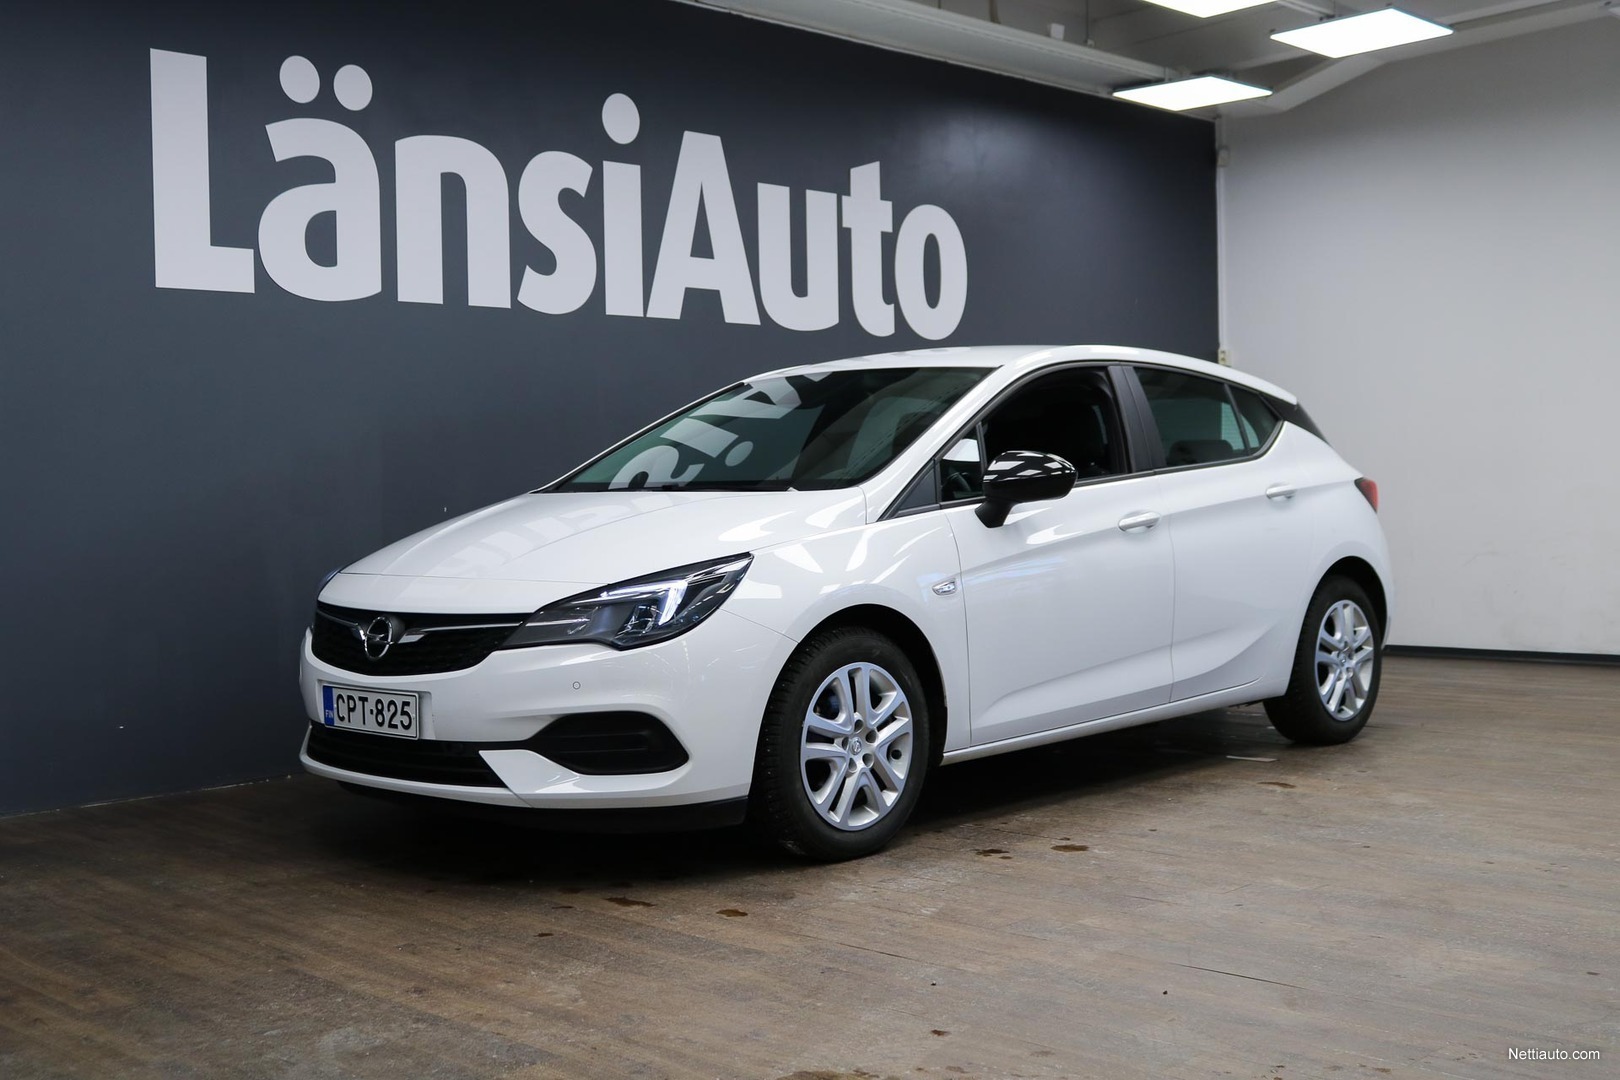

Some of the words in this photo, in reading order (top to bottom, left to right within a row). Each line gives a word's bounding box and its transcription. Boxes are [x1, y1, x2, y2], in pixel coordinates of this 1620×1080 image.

[150, 49, 967, 340] LänsiAuto
[325, 709, 335, 718] FIN
[336, 693, 412, 730] CPT-825
